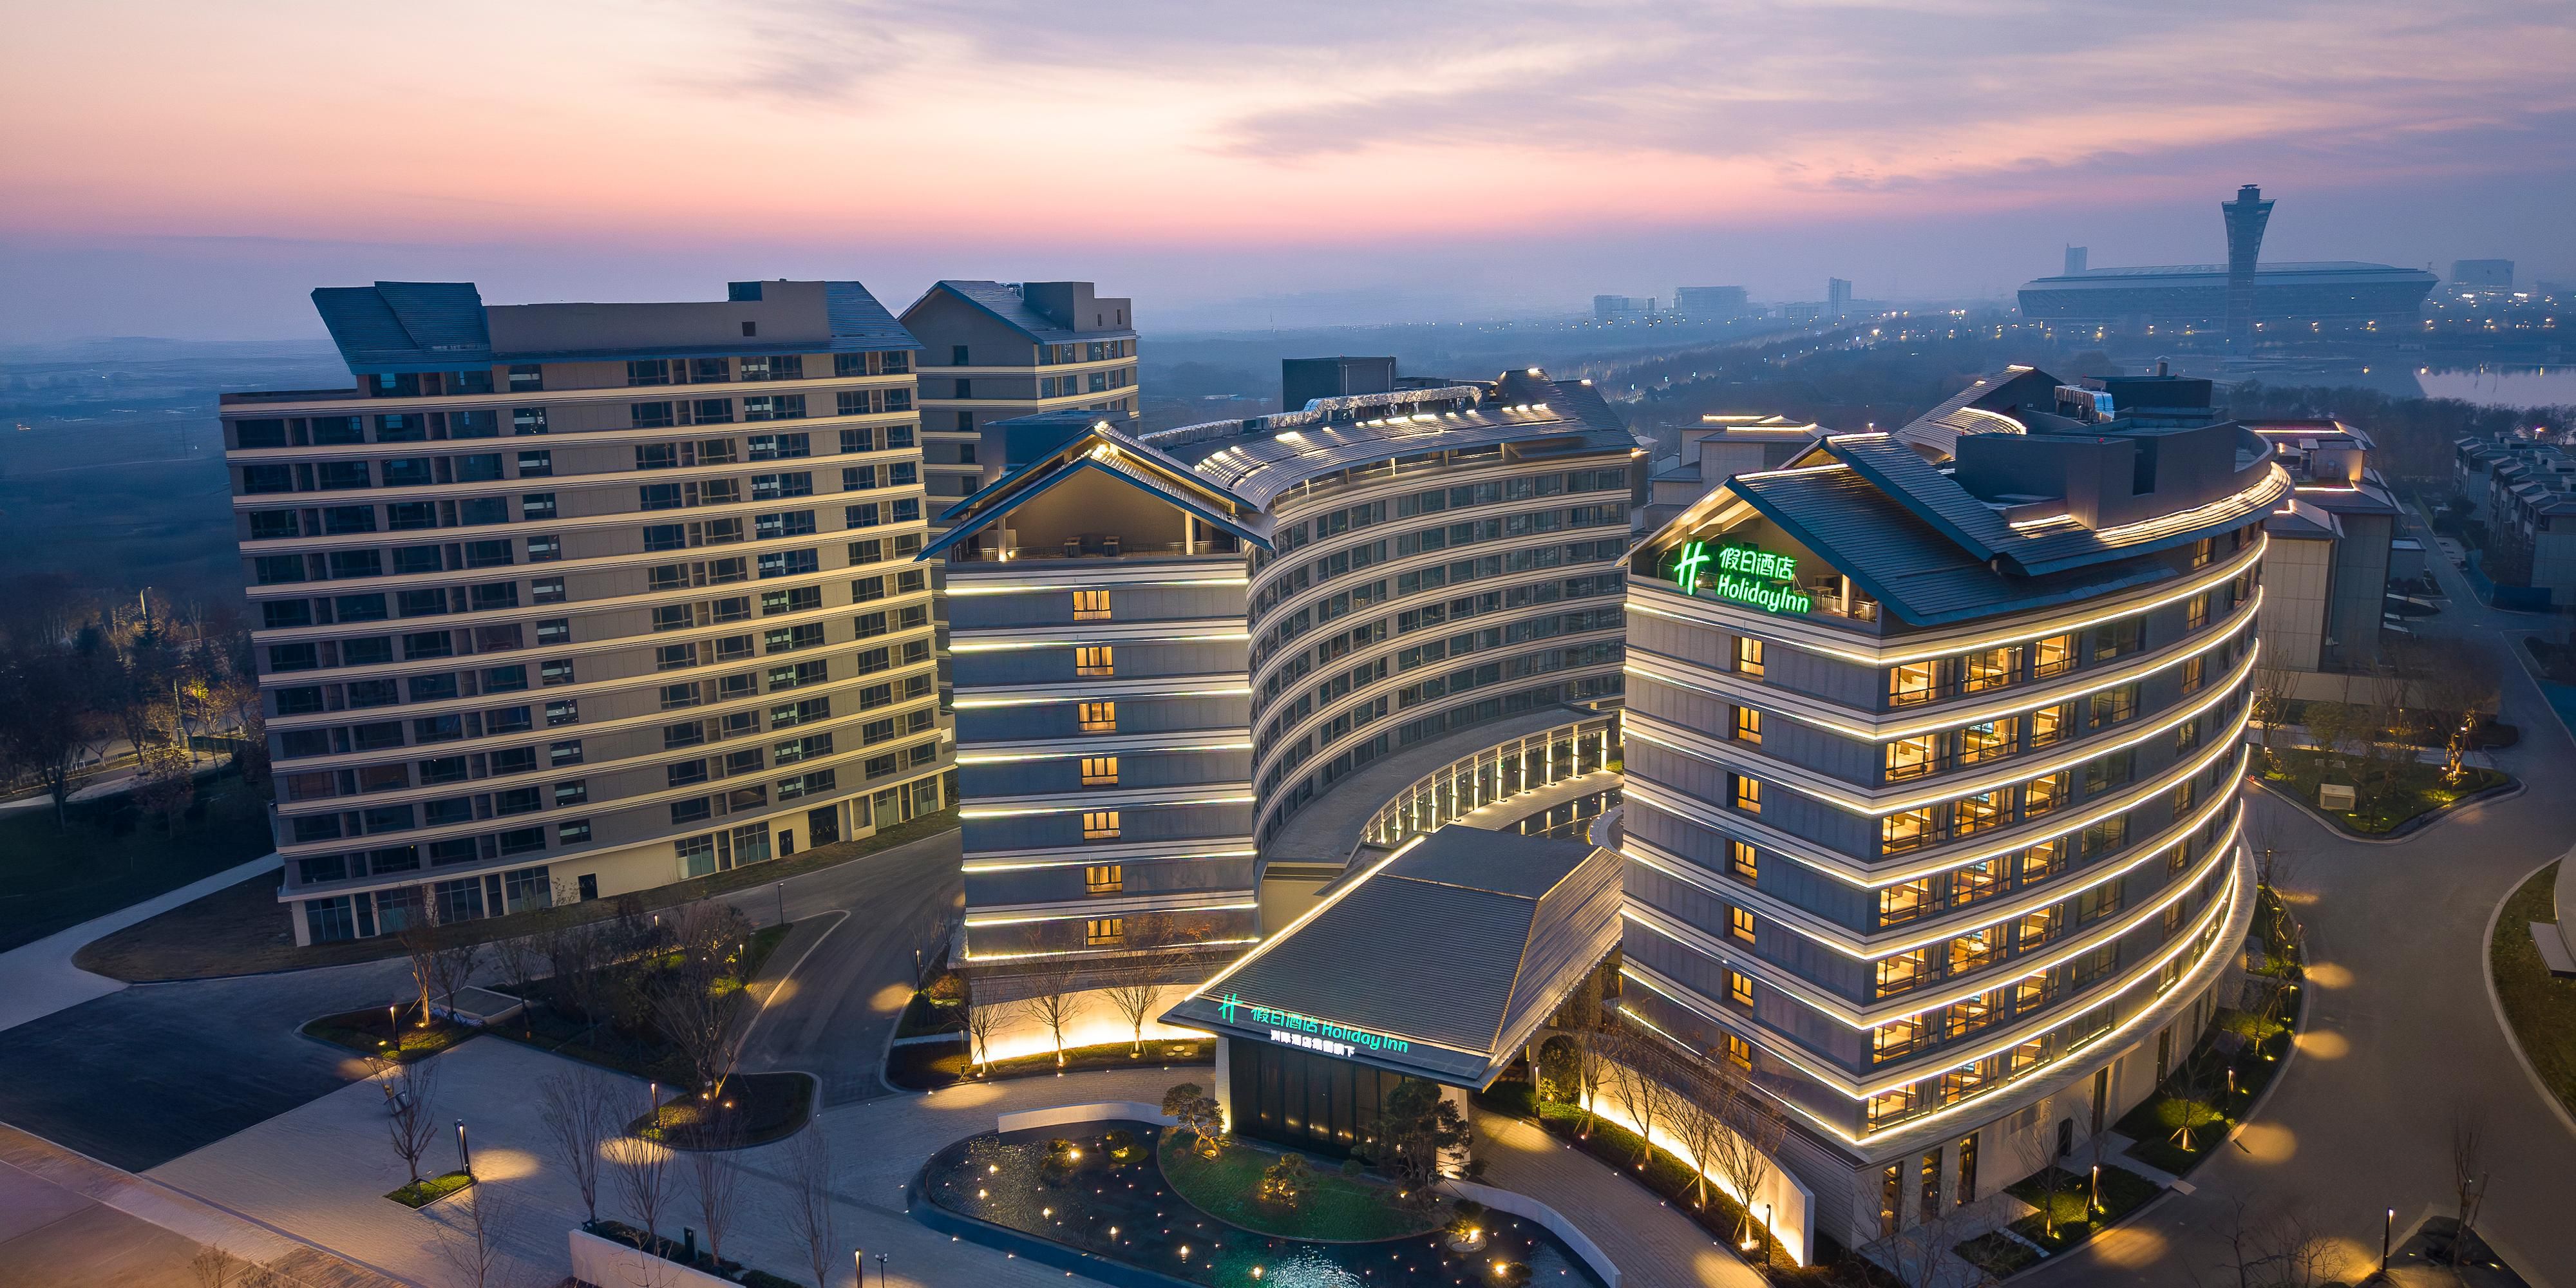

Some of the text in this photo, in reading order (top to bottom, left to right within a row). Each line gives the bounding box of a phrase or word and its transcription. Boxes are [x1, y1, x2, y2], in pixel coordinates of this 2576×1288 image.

[1719, 547, 1797, 580] 假日酒店
[1251, 1005, 1319, 1034] 假日酒店
[1321, 1020, 1381, 1050] Holiday
[1383, 1032, 1408, 1053] Inn
